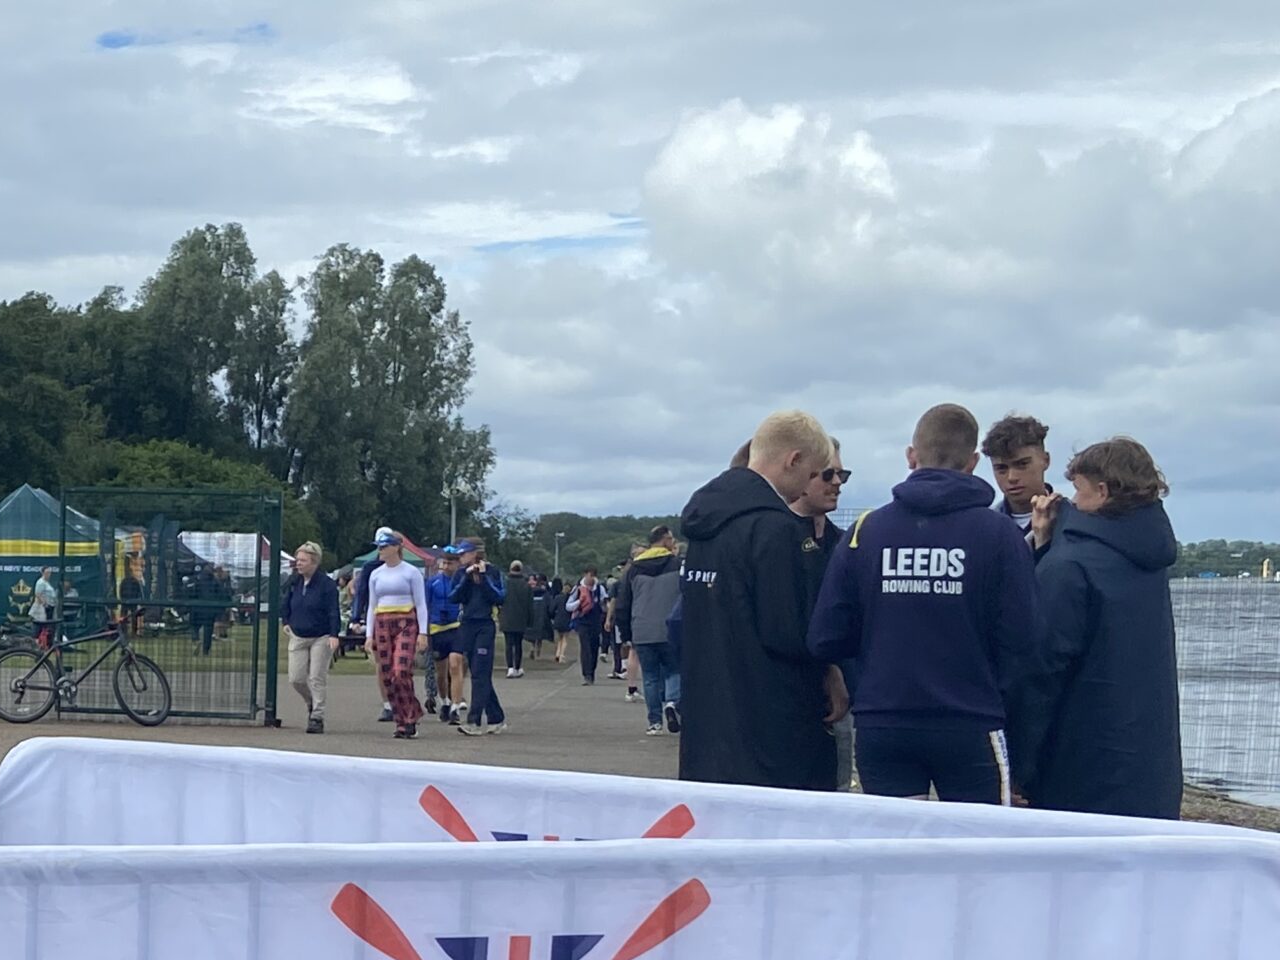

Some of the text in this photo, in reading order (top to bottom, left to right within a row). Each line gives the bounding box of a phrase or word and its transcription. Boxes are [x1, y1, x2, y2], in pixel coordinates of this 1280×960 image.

[882, 548, 965, 577] LEEDS
[882, 580, 963, 594] ROWING CLUB
